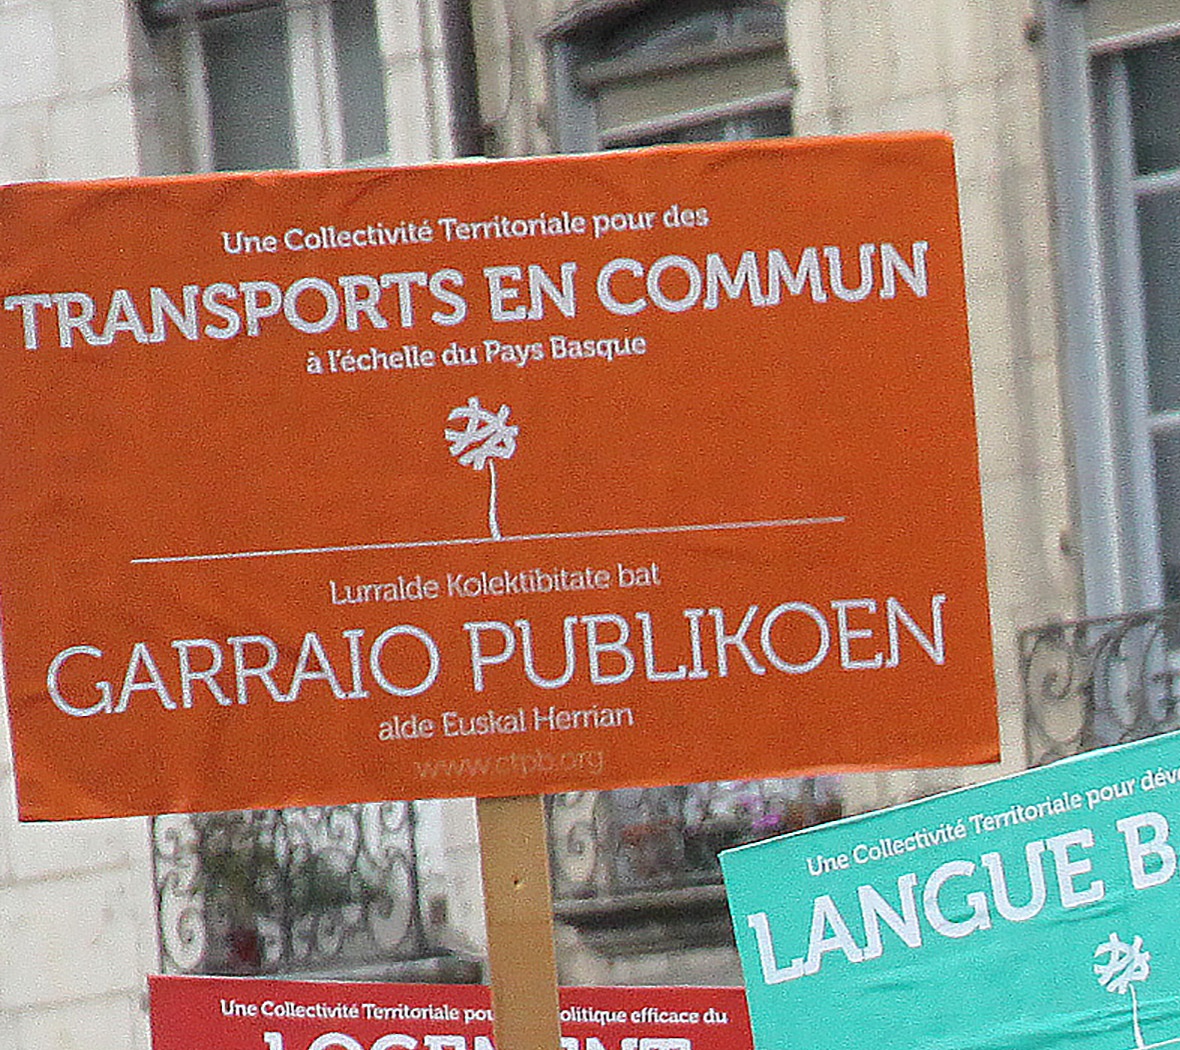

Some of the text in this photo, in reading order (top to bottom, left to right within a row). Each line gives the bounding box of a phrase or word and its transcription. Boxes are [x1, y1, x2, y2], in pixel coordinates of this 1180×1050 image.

[221, 204, 710, 255] Une Collectivité Territoriale pour des
[4, 240, 929, 350] TRANSPORTS EN COMMUN
[306, 335, 647, 374] à l'échelle du Pays Basque
[329, 562, 661, 606] Lurralde Kolektibitate bat
[46, 593, 946, 717] GARRAIO PUBLIKOEN
[378, 706, 634, 741] alde Euskal Herrian
[806, 854, 850, 877] Une
[852, 818, 967, 865] Collectivité
[968, 791, 1084, 835] Territoriale
[1085, 778, 1136, 810] pour
[747, 828, 1106, 985] LANGUE
[220, 999, 728, 1027] Une Collectivité Territoriale pou olitique efficace du
